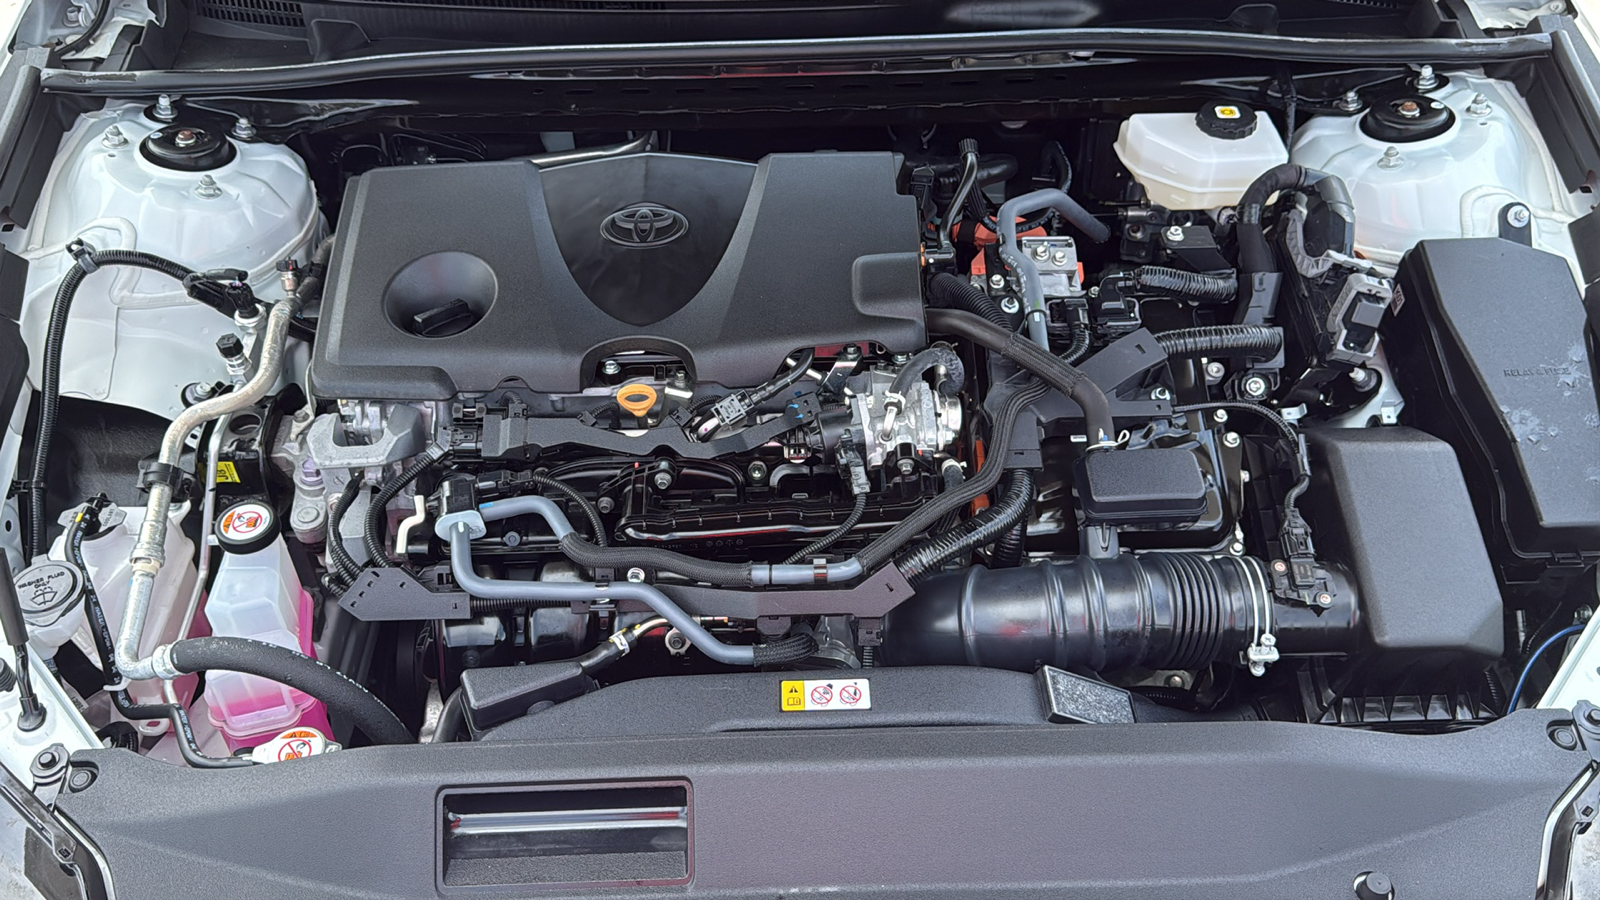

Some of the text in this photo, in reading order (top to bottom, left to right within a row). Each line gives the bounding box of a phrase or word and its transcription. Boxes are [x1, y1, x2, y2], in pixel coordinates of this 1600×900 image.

[18, 571, 66, 590] WASHER FLUID
[34, 580, 51, 589] ONLY
